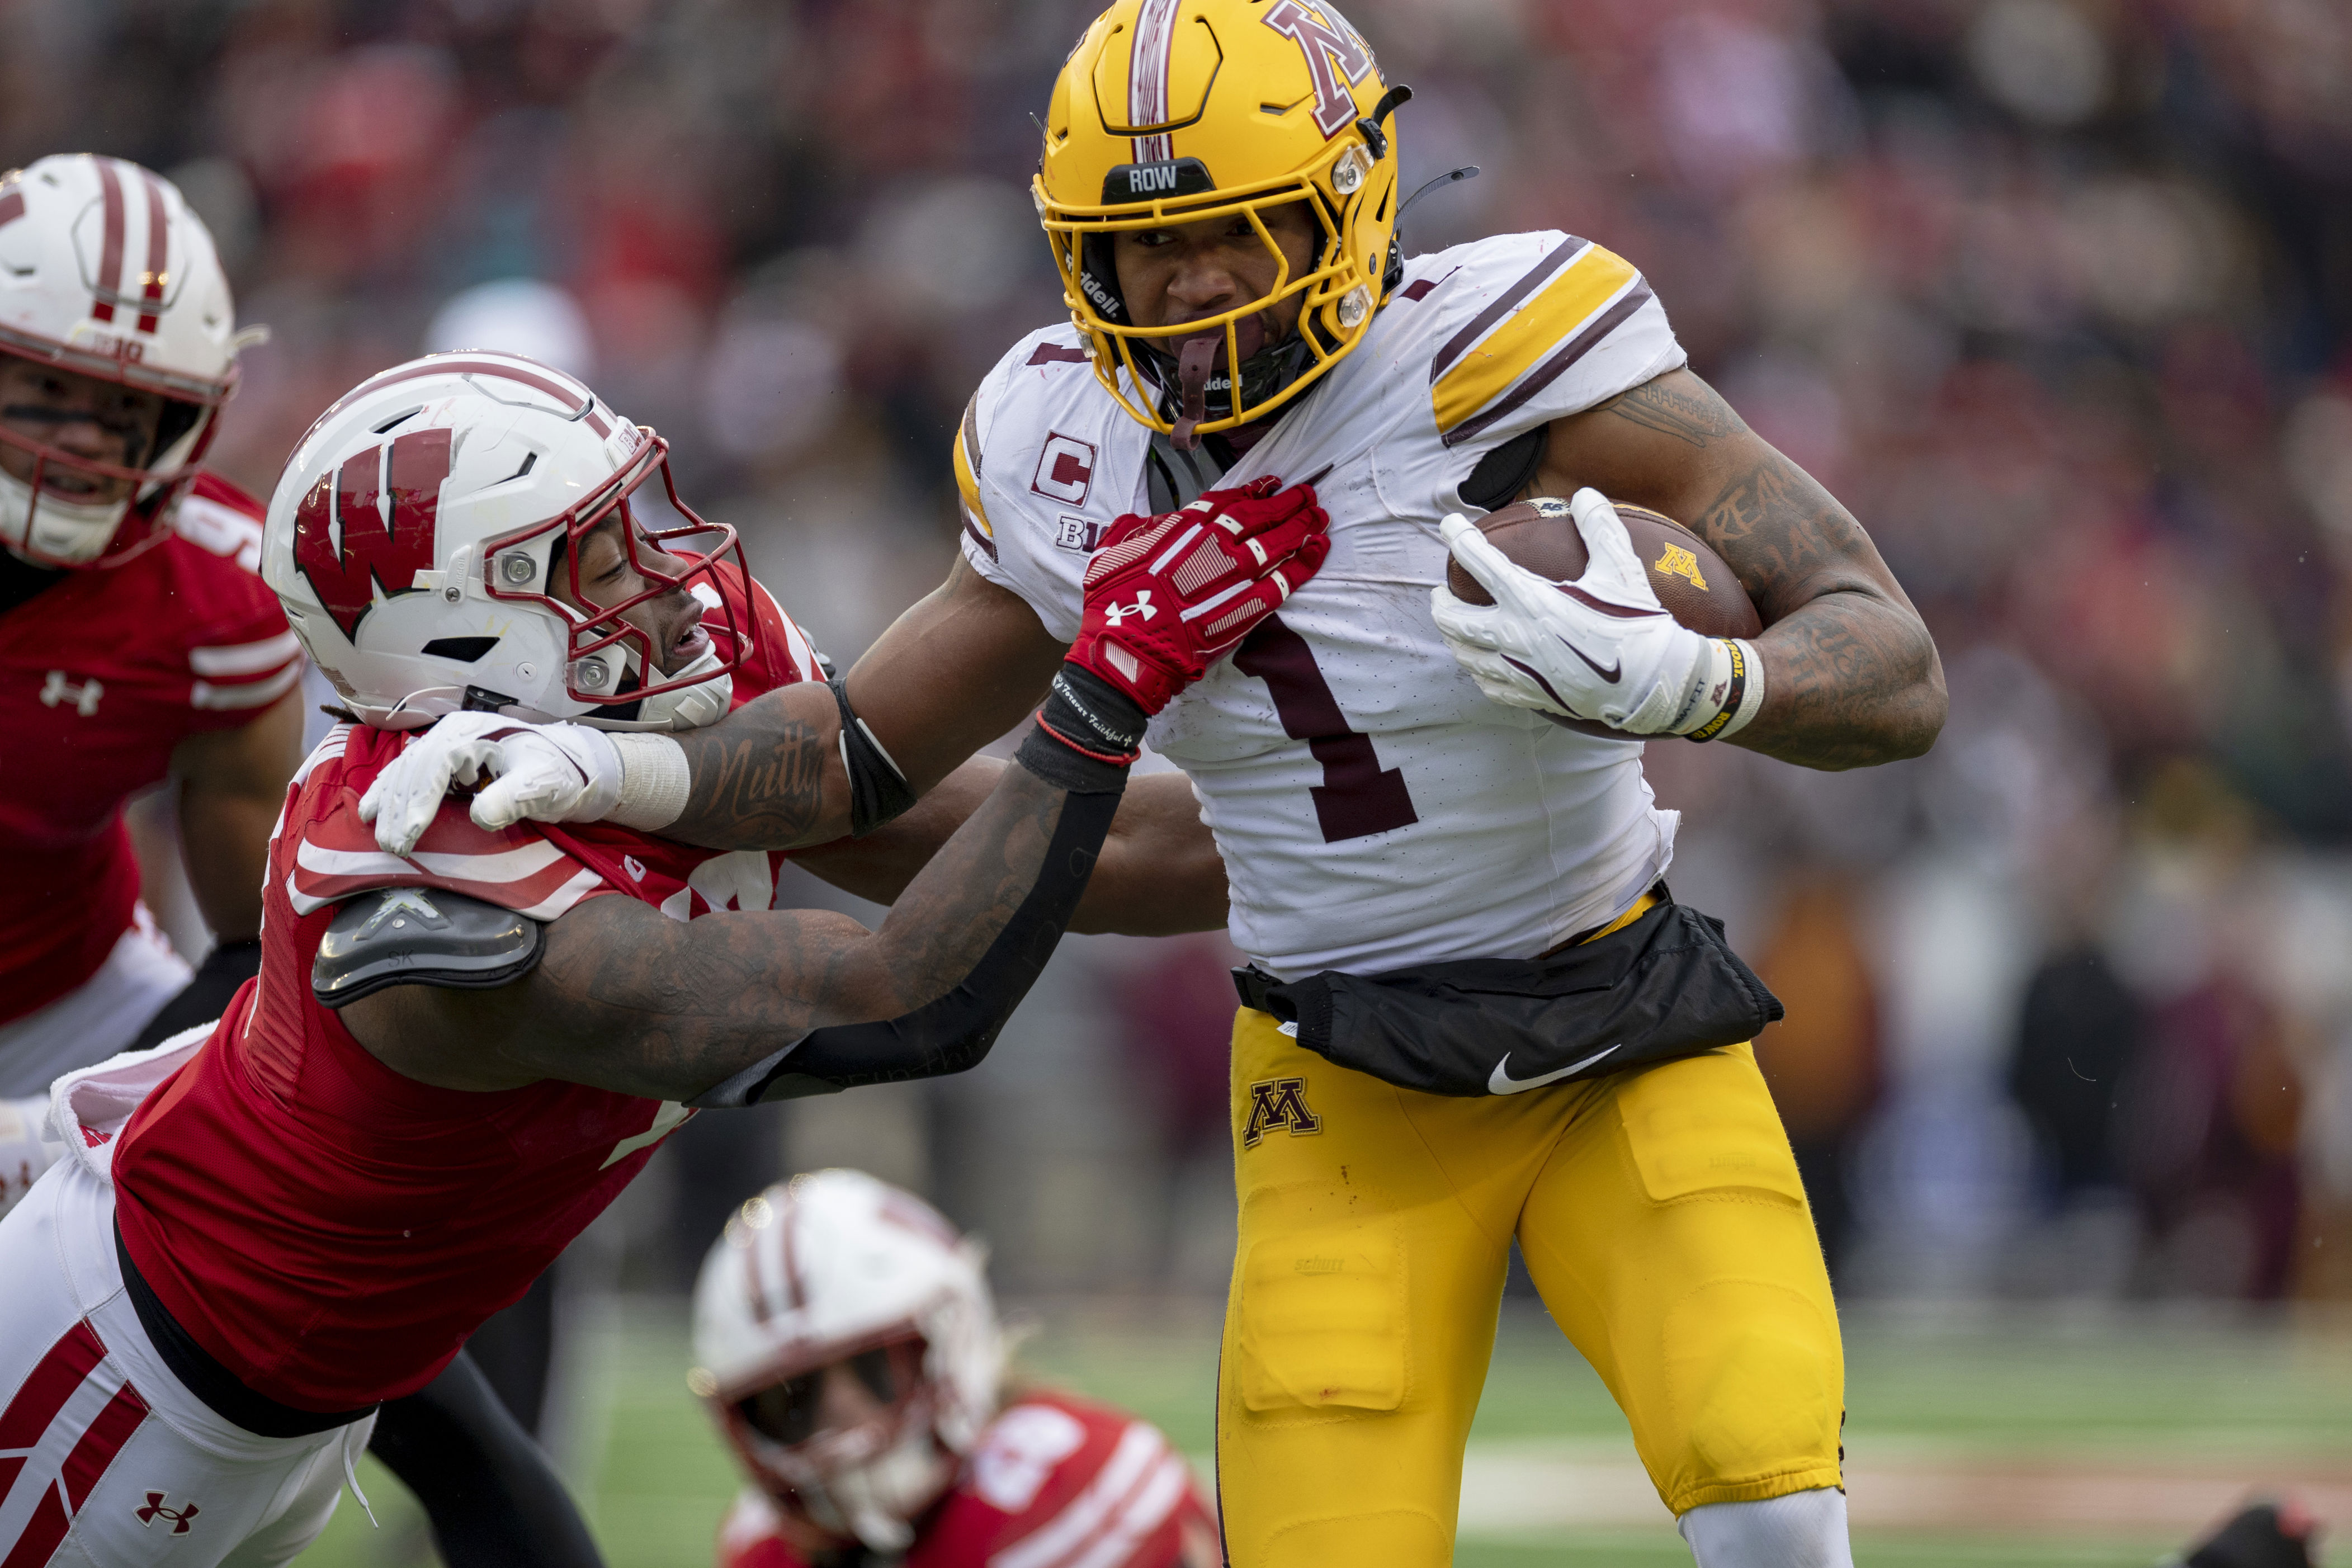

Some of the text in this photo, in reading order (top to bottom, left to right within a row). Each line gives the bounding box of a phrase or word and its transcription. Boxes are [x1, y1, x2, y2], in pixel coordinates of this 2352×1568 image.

[1129, 166, 1177, 193] ROW
[1065, 253, 1120, 314] Rddell
[1035, 436, 1093, 502] C
[294, 427, 454, 646] W
[1655, 542, 1706, 591] M
[1062, 684, 1124, 741] Forever Faithful
[1706, 712, 1731, 735] ROW
[388, 950, 414, 967] SK
[1243, 1076, 1322, 1150] M
